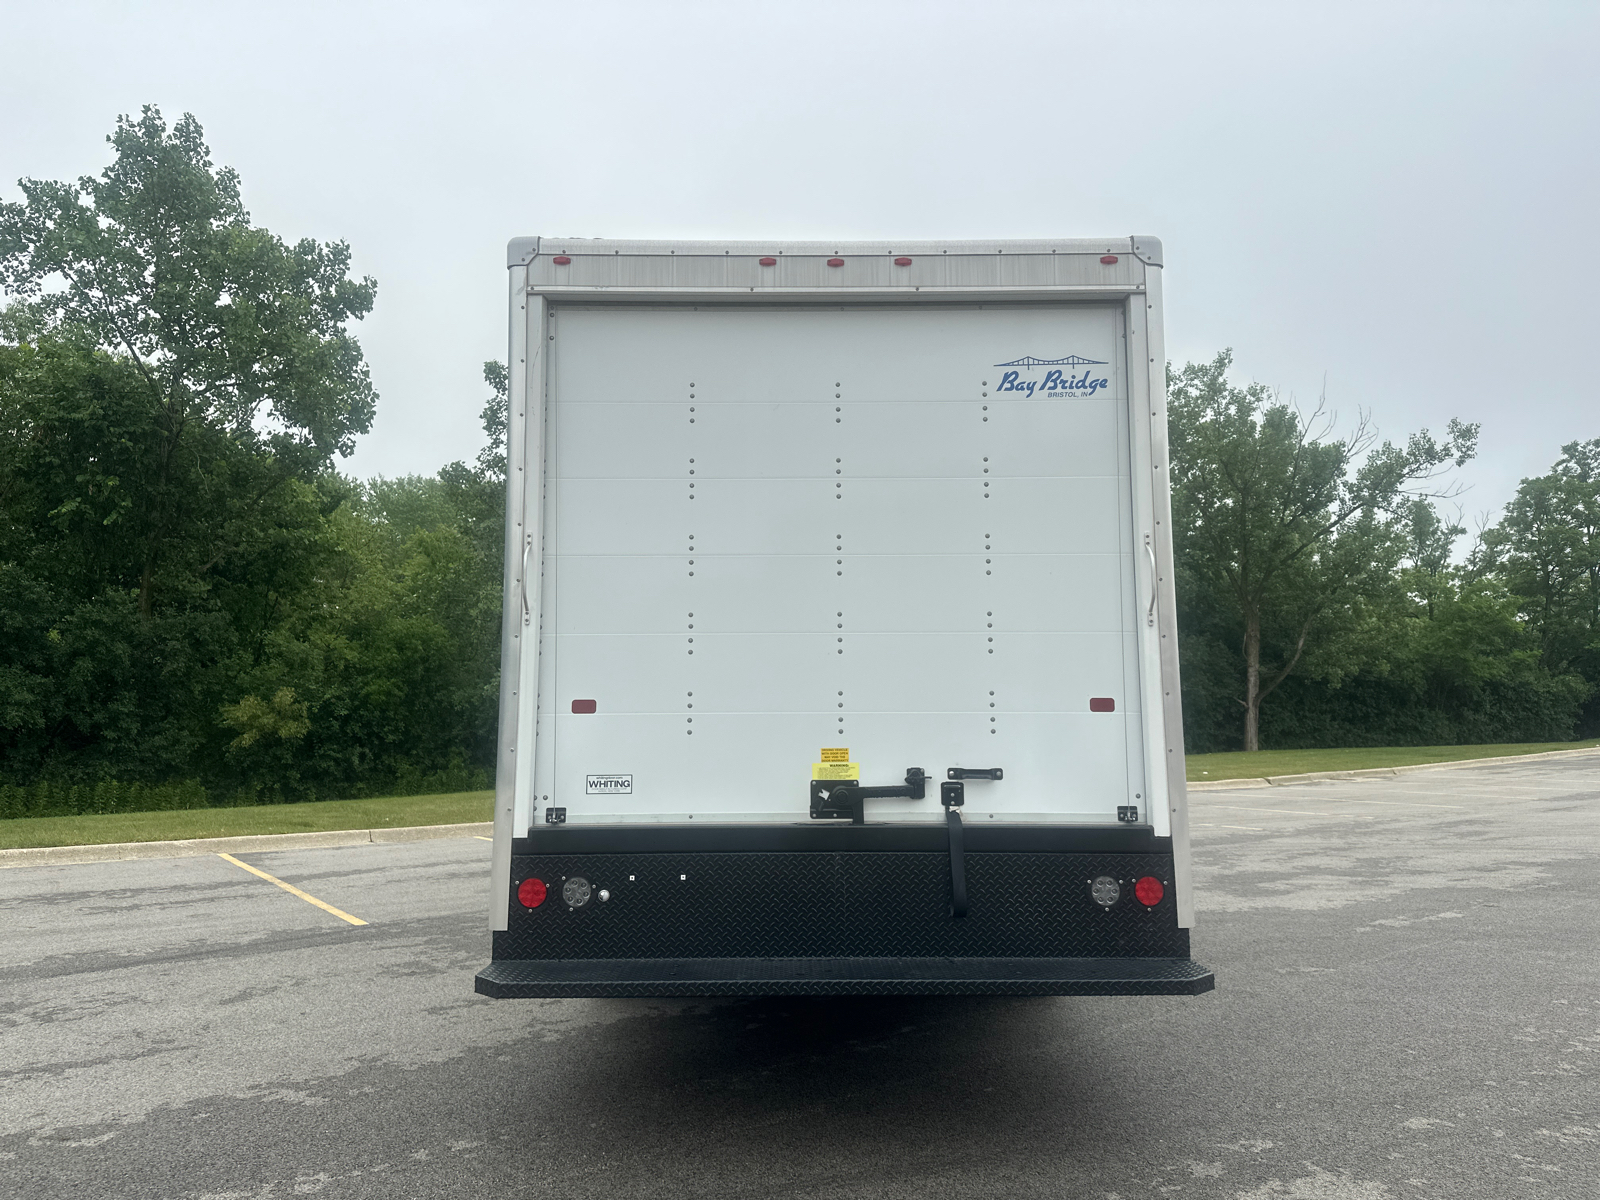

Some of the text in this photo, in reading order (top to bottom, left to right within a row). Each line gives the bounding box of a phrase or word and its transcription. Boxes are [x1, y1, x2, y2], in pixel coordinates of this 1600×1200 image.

[996, 369, 1109, 398] Bay Bridge
[588, 780, 630, 788] WHITING
